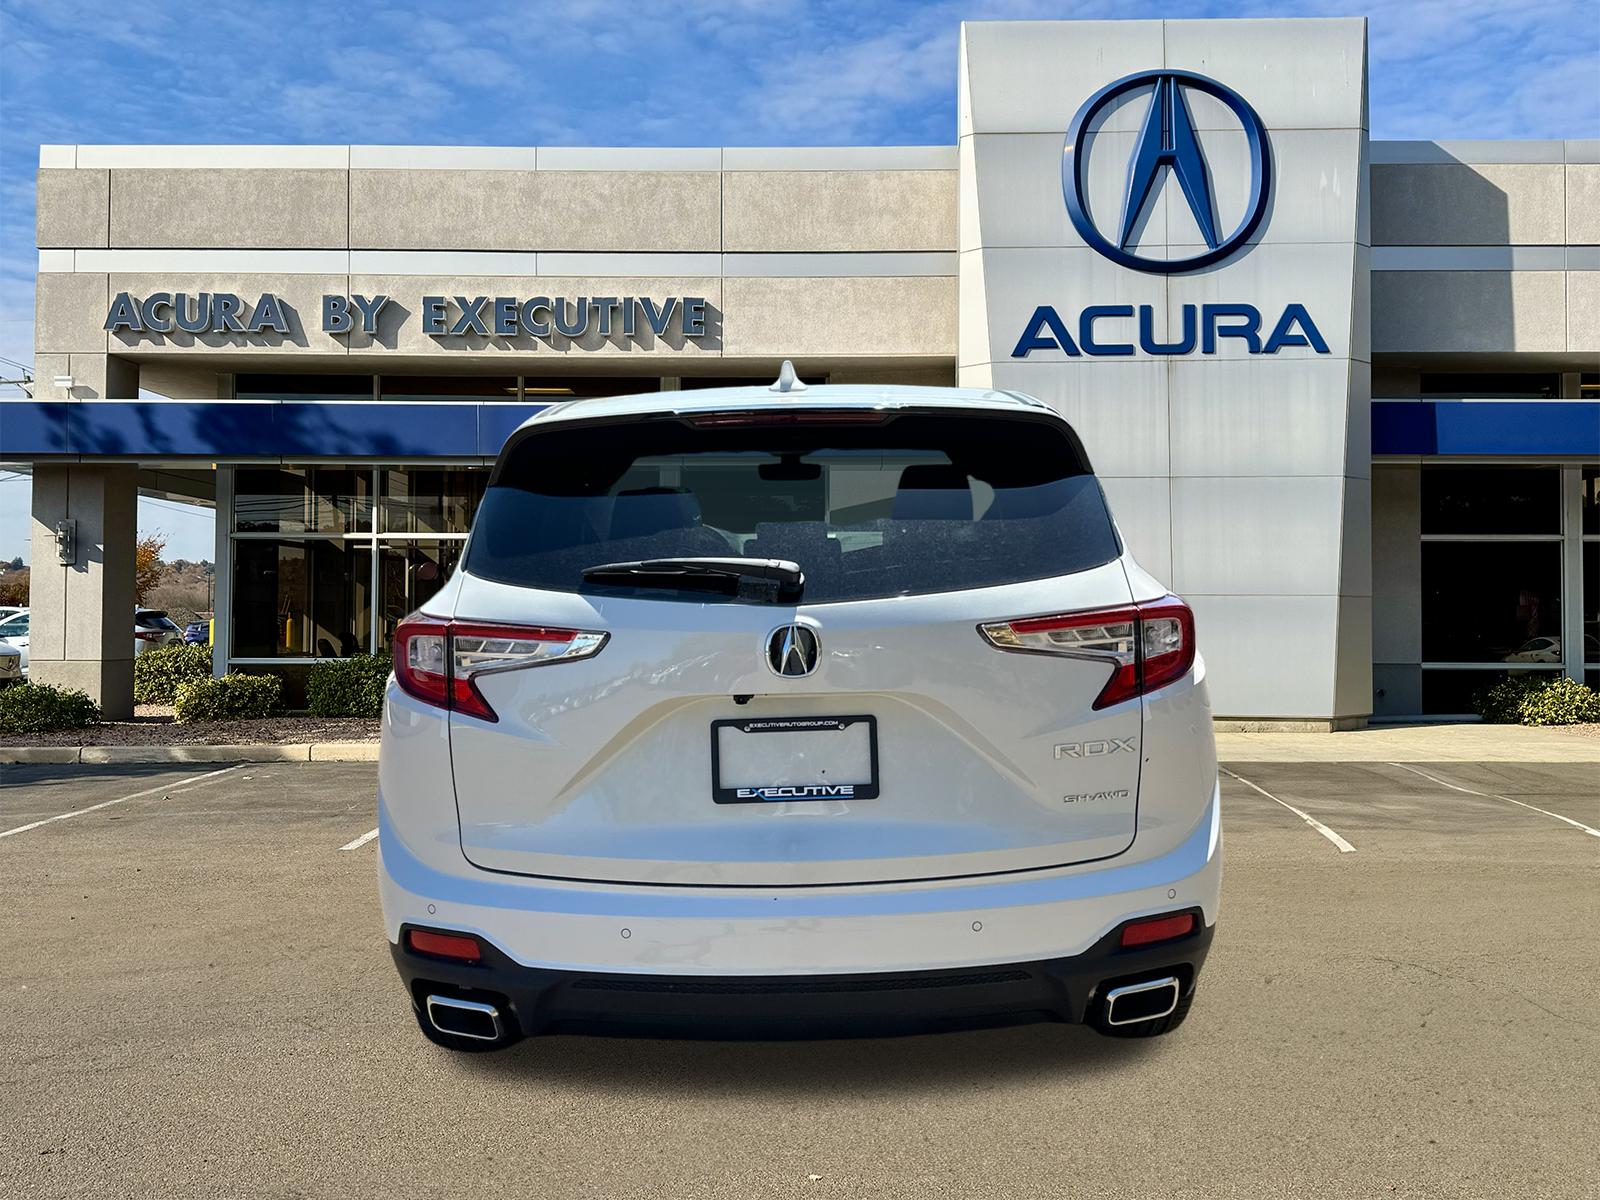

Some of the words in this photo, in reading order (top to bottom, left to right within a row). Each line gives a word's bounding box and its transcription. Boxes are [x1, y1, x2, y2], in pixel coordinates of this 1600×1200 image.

[103, 291, 290, 335] ACURA
[322, 294, 390, 335] BY
[422, 296, 706, 338] EXECUTIVE
[1011, 303, 1332, 358] ACURA
[1053, 736, 1136, 761] RDX
[736, 785, 855, 801] EXECUTIVE
[1063, 789, 1131, 804] SH-AWD
